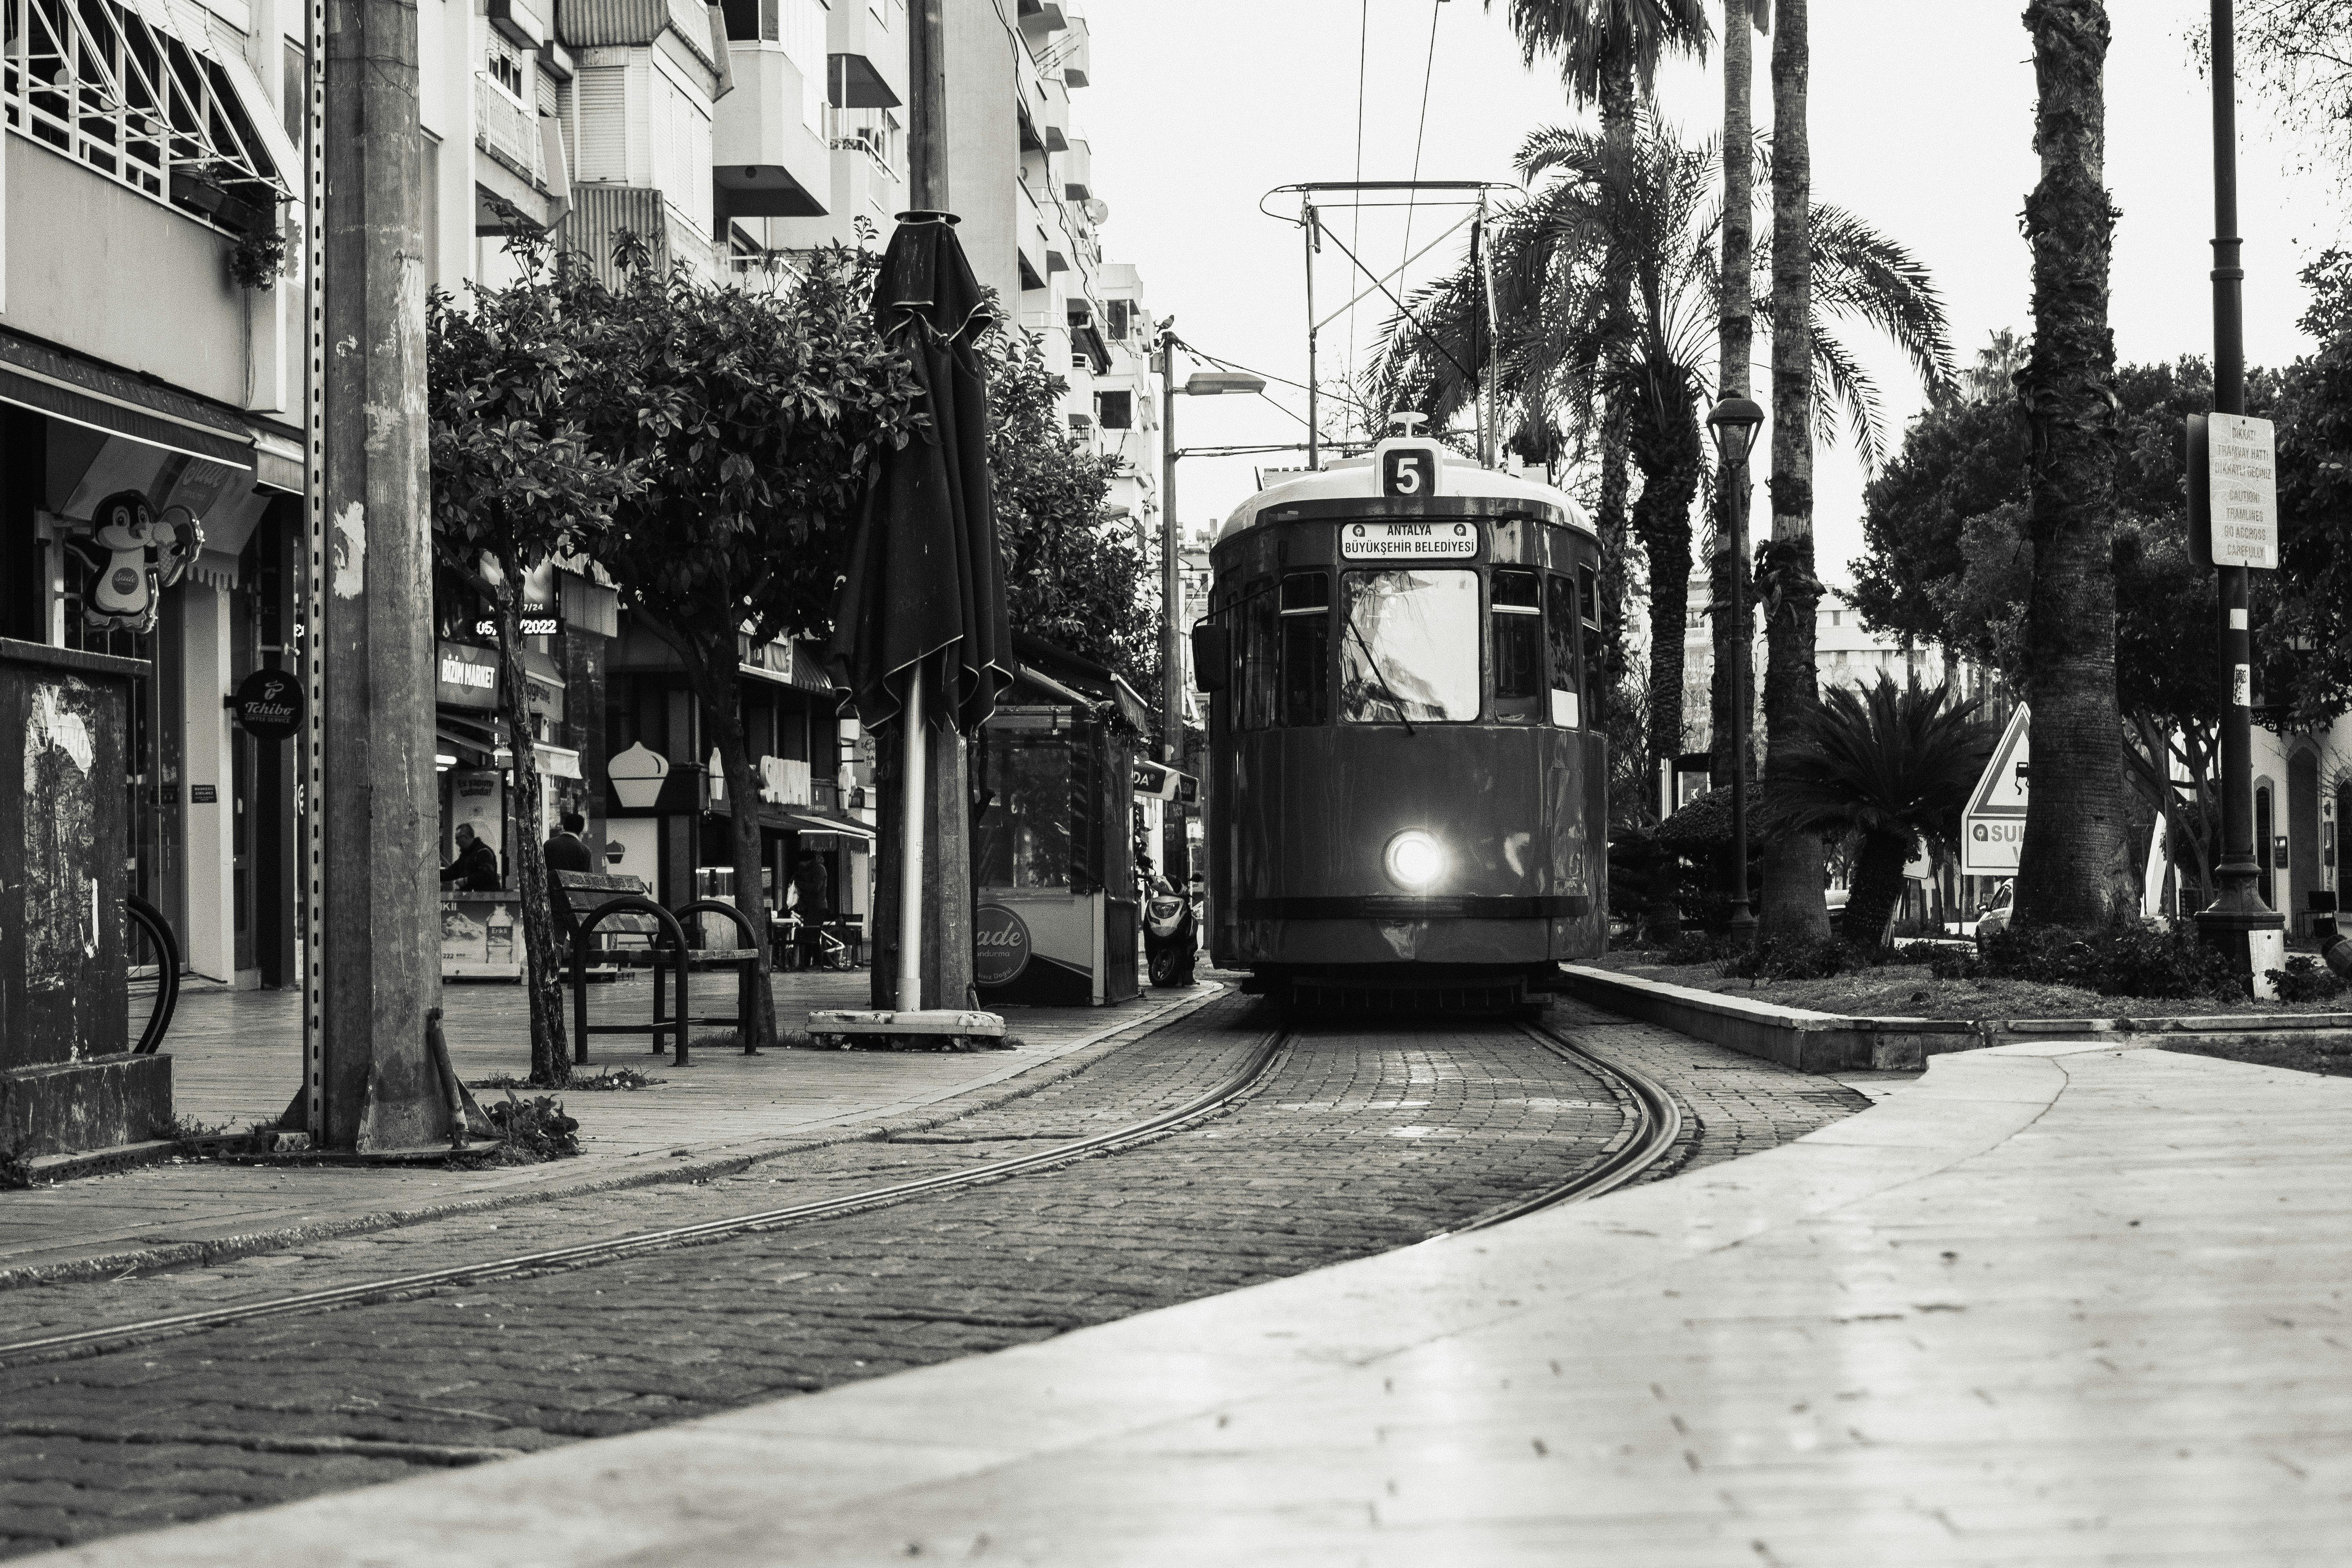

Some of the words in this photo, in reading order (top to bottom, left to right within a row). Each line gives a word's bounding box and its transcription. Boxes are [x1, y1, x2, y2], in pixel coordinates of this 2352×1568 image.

[1396, 458, 1419, 494] 5
[2227, 508, 2263, 522] TRAMLINES
[1387, 524, 1432, 536] ANTALYA
[2224, 525, 2234, 537] GO
[2236, 526, 2266, 541] ACCROSS
[1345, 539, 1411, 555] BÜYÜKŞEHİR
[1415, 539, 1474, 552] BELEDİYESİ
[2227, 544, 2264, 558] CAREFULLY
[524, 603, 543, 612] 7/24
[442, 654, 464, 684] BİZİM
[464, 663, 495, 689] MARKET
[245, 702, 295, 715] Tchibo
[977, 922, 1023, 947] ade
